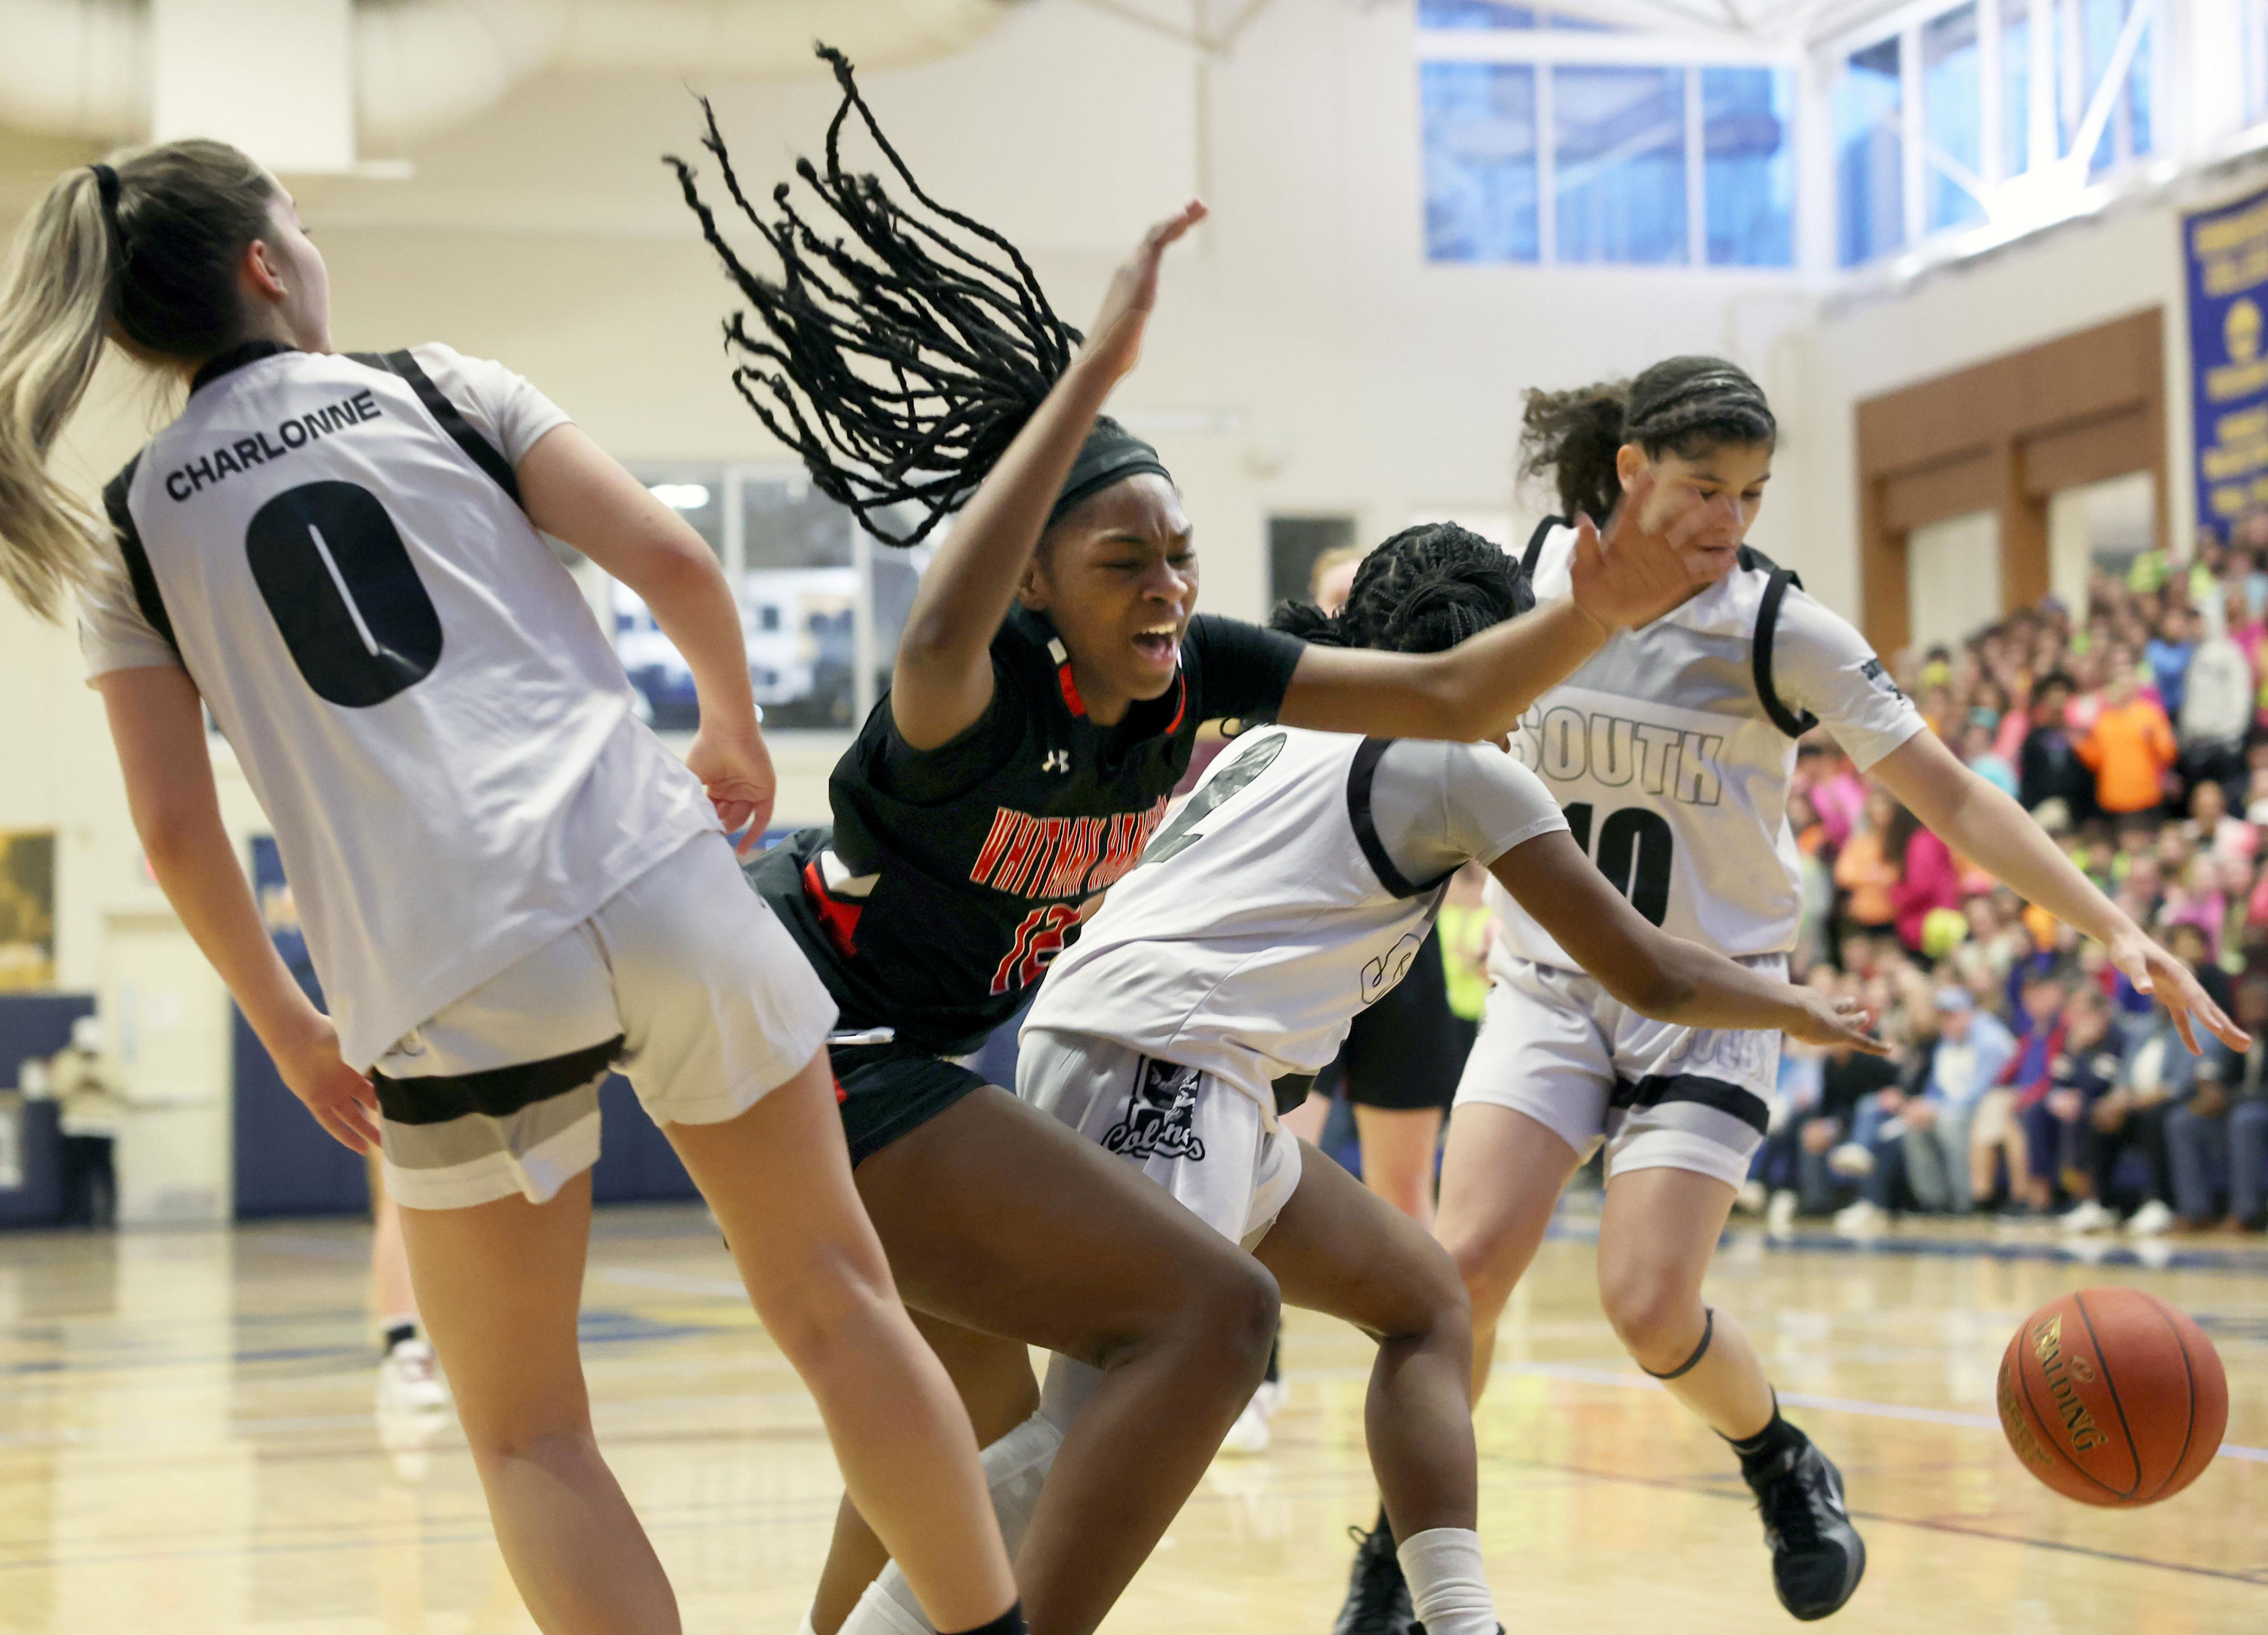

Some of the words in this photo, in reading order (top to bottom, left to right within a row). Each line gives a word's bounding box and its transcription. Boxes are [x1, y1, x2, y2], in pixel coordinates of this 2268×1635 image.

[165, 390, 382, 502] CHARLONNE
[245, 481, 444, 708] 0
[1513, 704, 1724, 806] SOUTH
[989, 903, 1083, 996] 12
